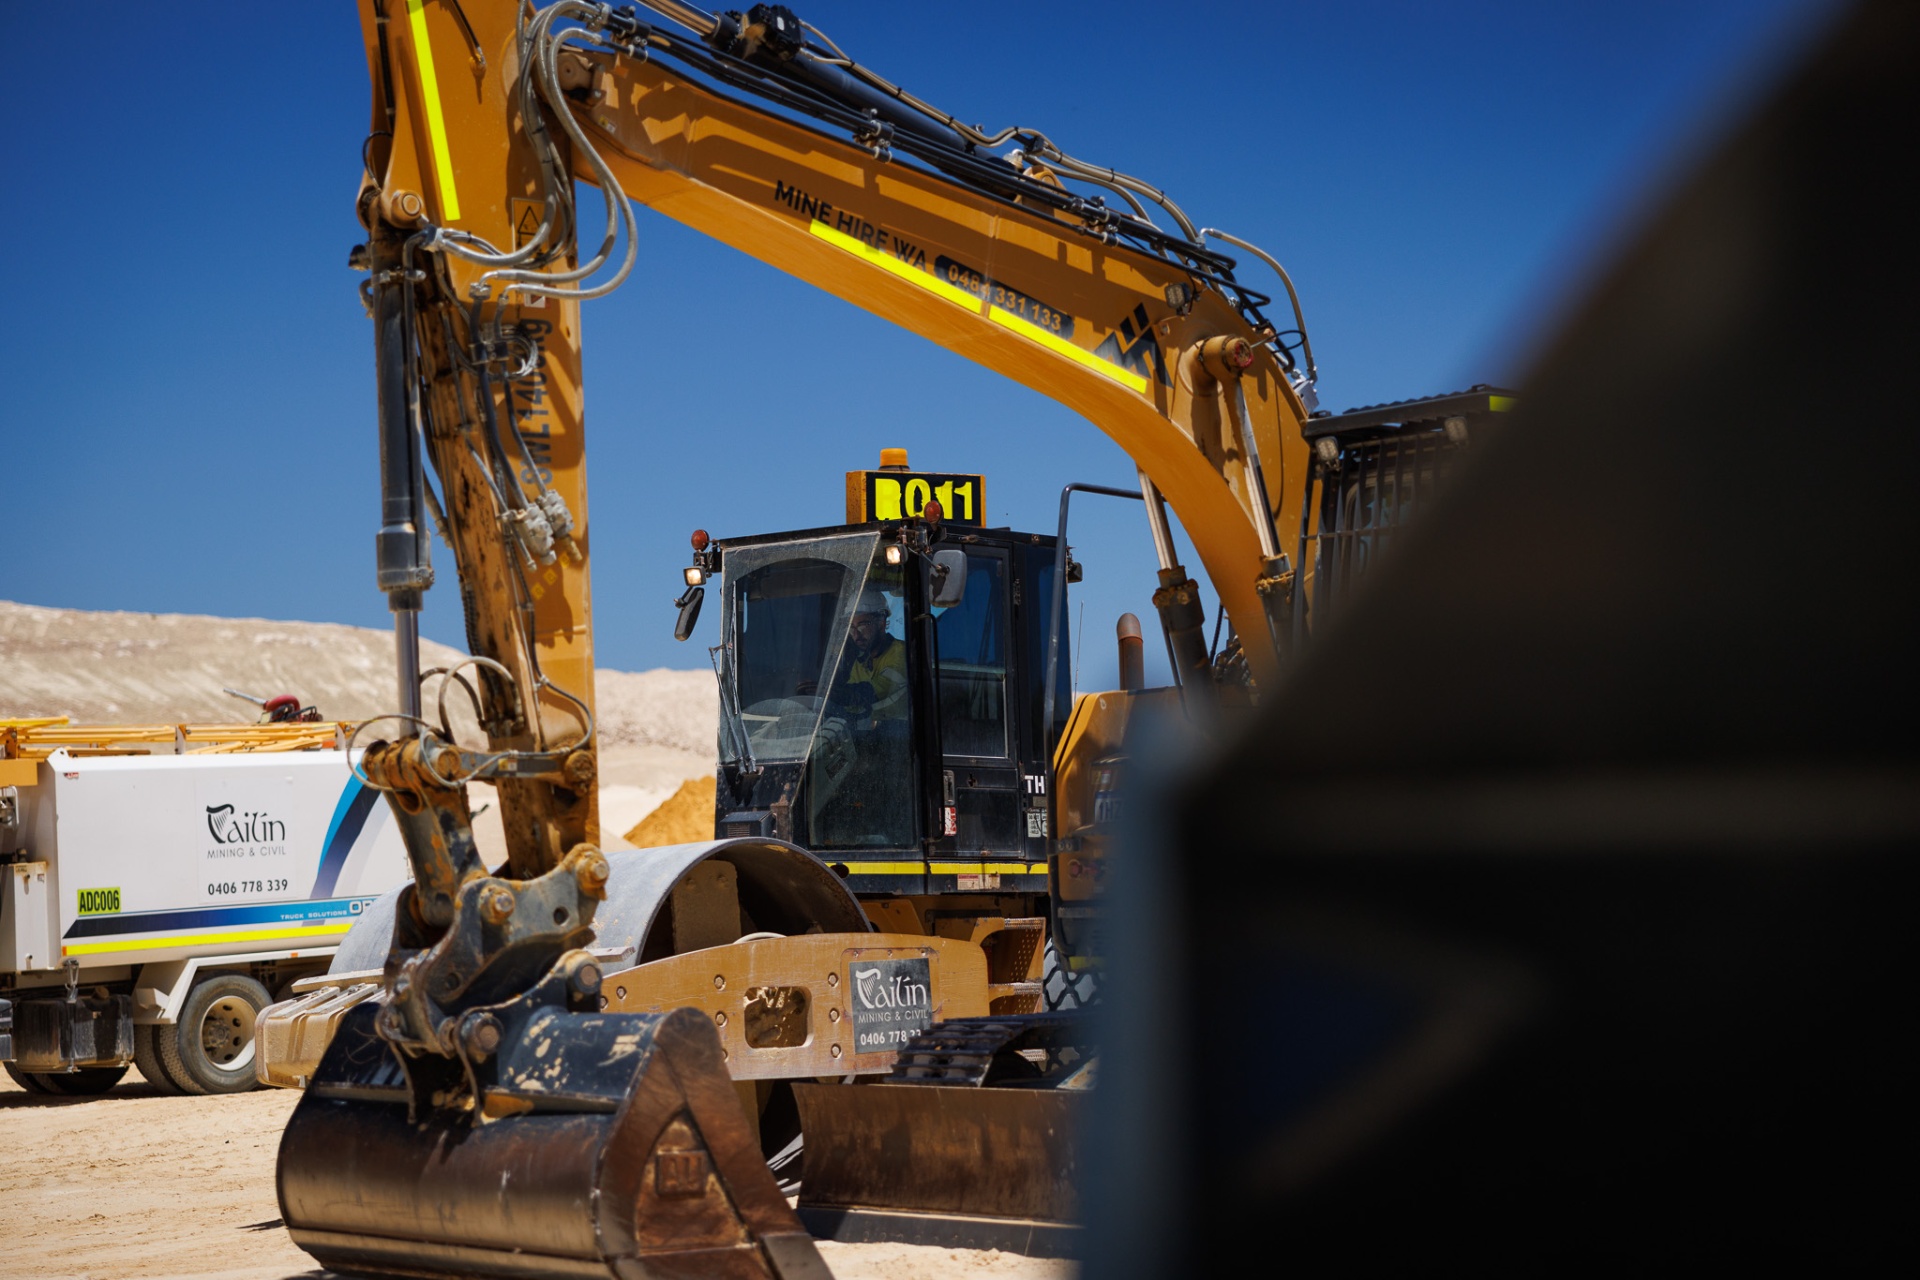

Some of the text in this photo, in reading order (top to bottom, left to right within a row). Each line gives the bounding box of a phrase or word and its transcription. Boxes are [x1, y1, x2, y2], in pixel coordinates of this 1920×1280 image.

[775, 180, 927, 273] MINE HIRE WA
[948, 264, 1062, 331] 0484 331 133
[519, 424, 553, 485] SWL
[207, 845, 287, 860] MINING & CIVIL
[207, 878, 288, 896] 0406 778 339
[79, 889, 120, 913] ADC006
[280, 909, 348, 921] TRUCK SOLUTIONS
[859, 1010, 928, 1023] MINING & CIVIL
[860, 1032, 885, 1045] 0406
[889, 1031, 907, 1042] 778
